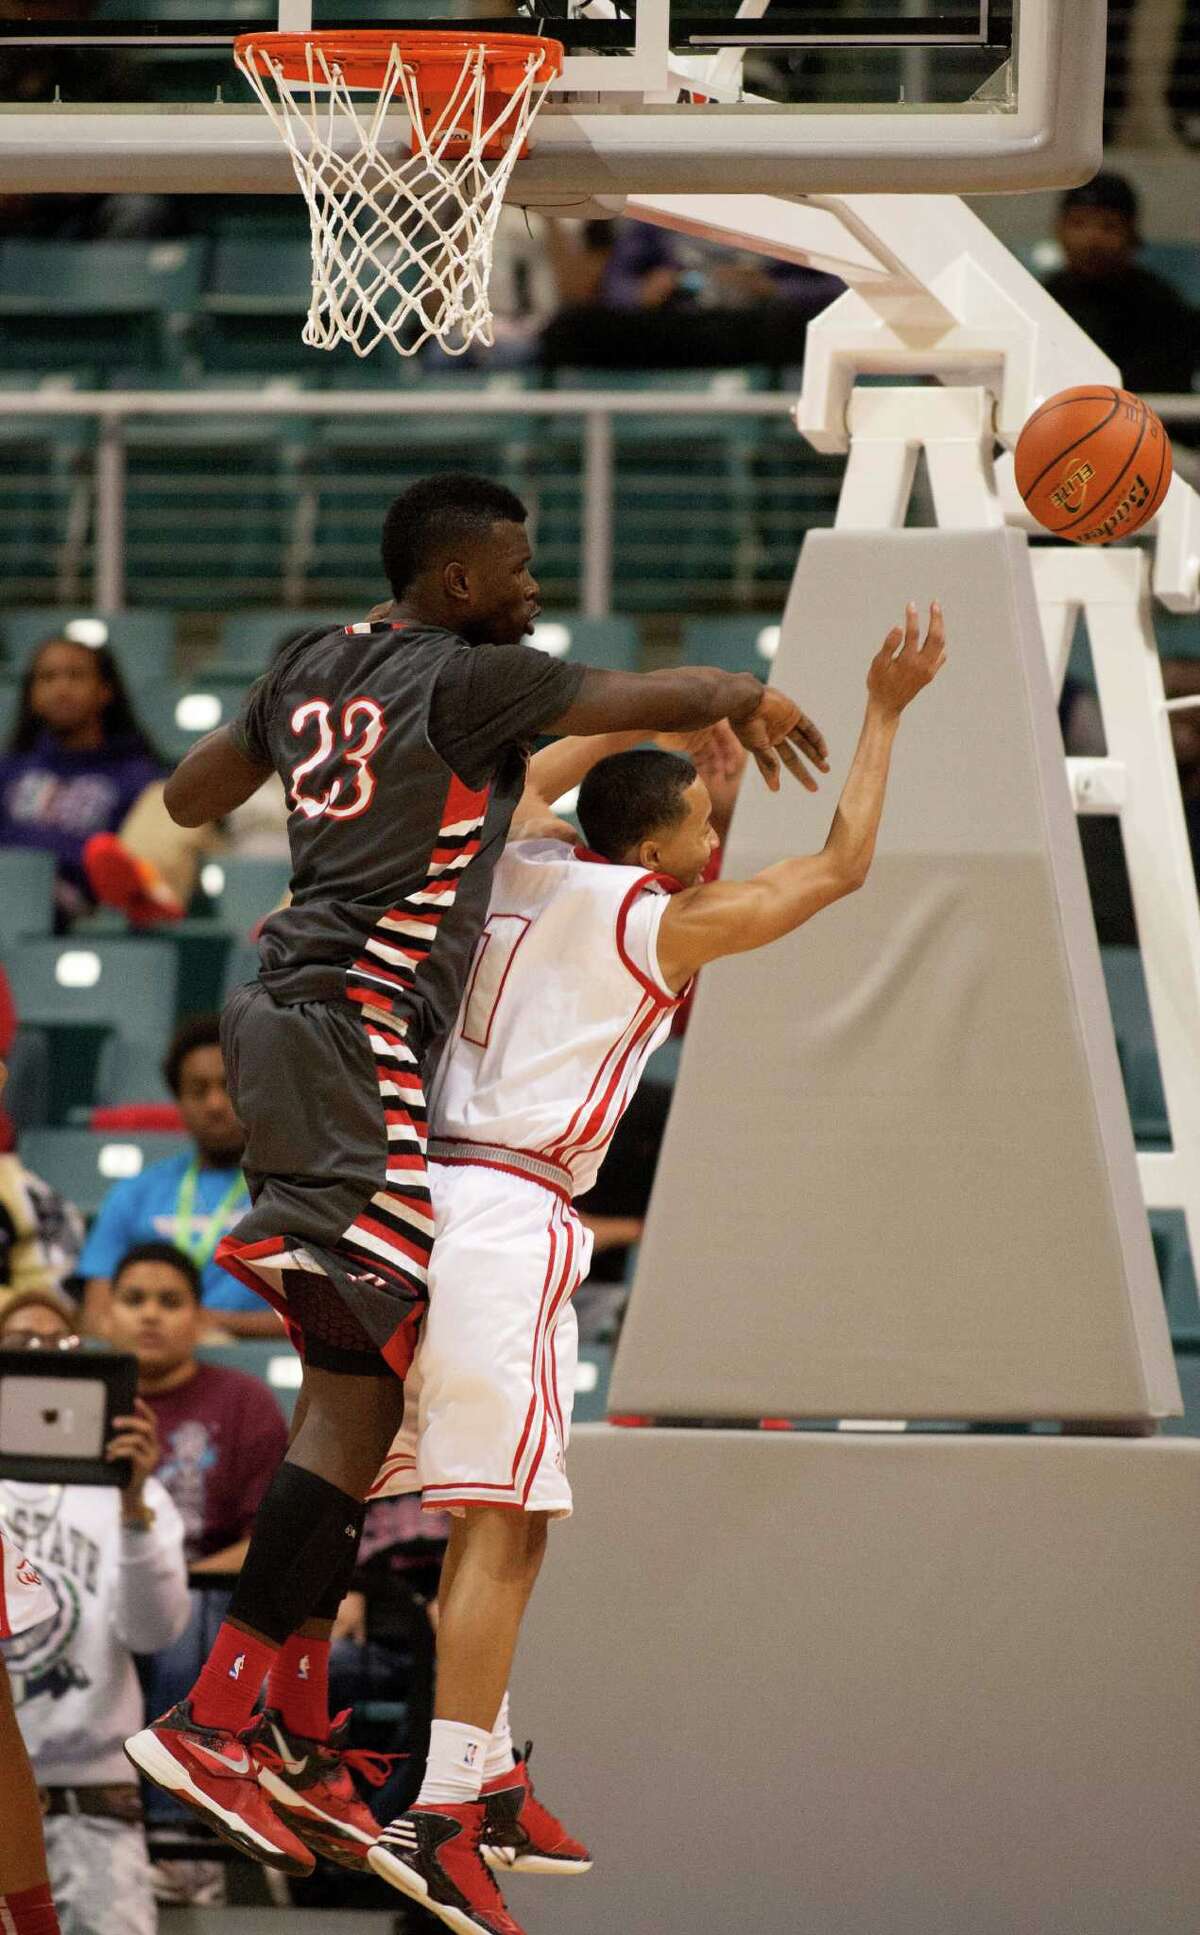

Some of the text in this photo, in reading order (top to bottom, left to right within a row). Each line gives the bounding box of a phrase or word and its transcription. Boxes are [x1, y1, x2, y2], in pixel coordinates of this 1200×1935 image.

[1051, 461, 1097, 508] ELITE
[289, 696, 388, 821] 23
[460, 912, 531, 1049] 1
